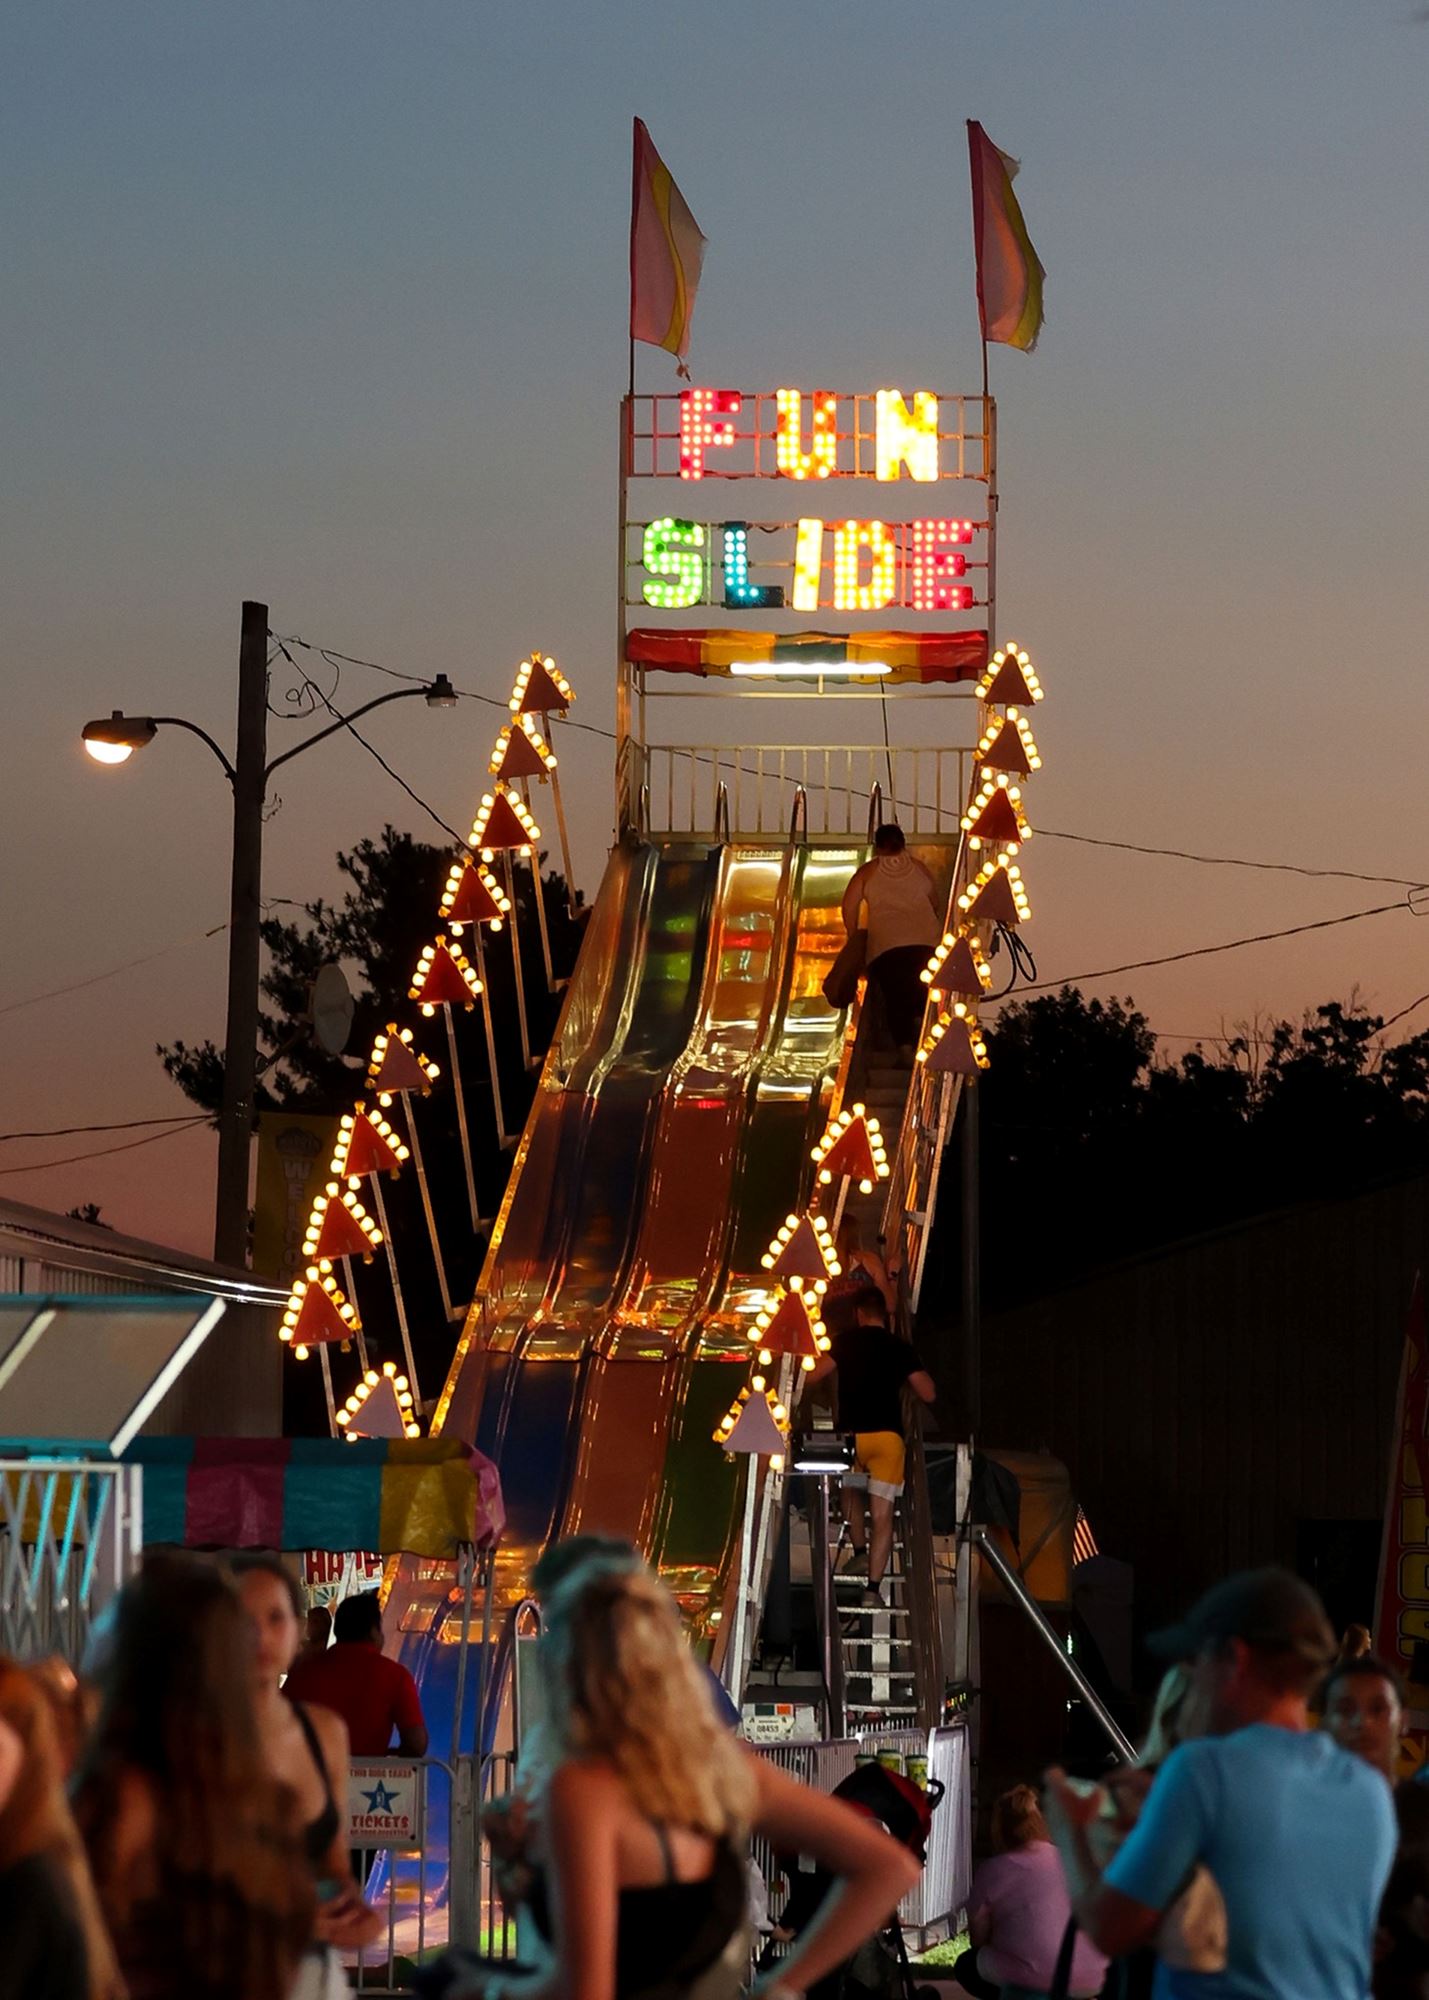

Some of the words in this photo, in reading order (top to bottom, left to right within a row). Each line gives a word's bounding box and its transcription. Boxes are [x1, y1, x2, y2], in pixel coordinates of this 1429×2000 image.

[680, 389, 939, 482] FUN
[642, 517, 973, 611] SLIDE
[351, 1815, 409, 1828] TICKETS
